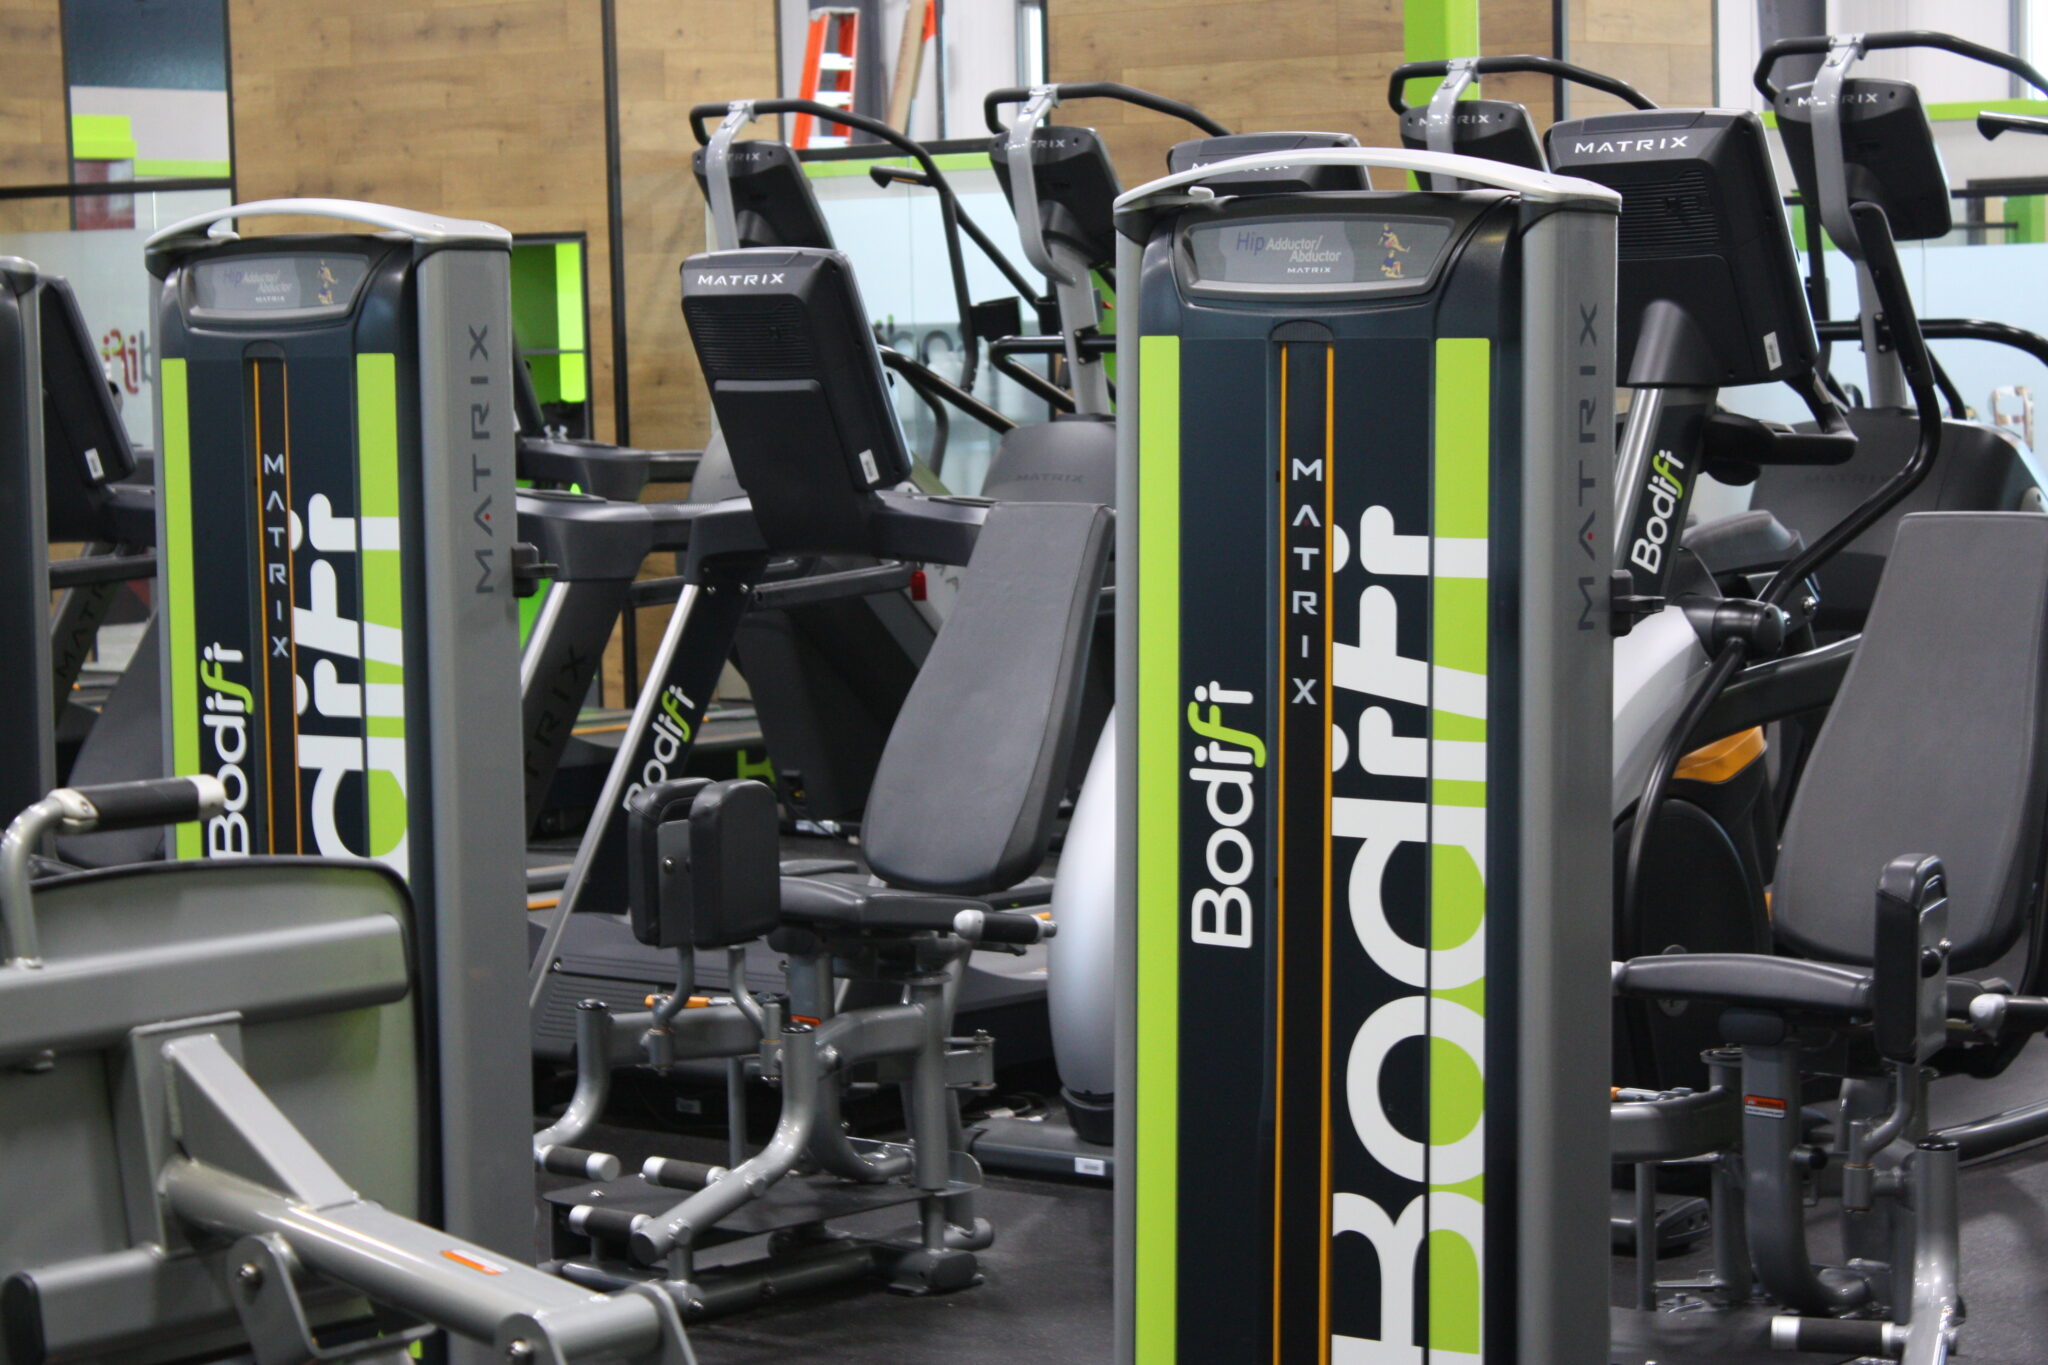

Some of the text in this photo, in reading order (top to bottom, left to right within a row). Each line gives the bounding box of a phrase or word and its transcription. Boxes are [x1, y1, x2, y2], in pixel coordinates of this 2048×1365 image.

[1797, 93, 1878, 107] MRIX
[1418, 113, 1489, 127] MRIX
[1574, 134, 1689, 154] MATRIX
[1236, 231, 1324, 256] Hip Adductor/
[1289, 249, 1342, 262] Abductor
[697, 271, 786, 287] MATRIX
[468, 324, 495, 594] MATRIX
[1577, 302, 1598, 631] MATRIX
[264, 453, 291, 658] MATRIX
[1292, 458, 1323, 706] MATRIX
[1187, 680, 1266, 949] Bodifi
